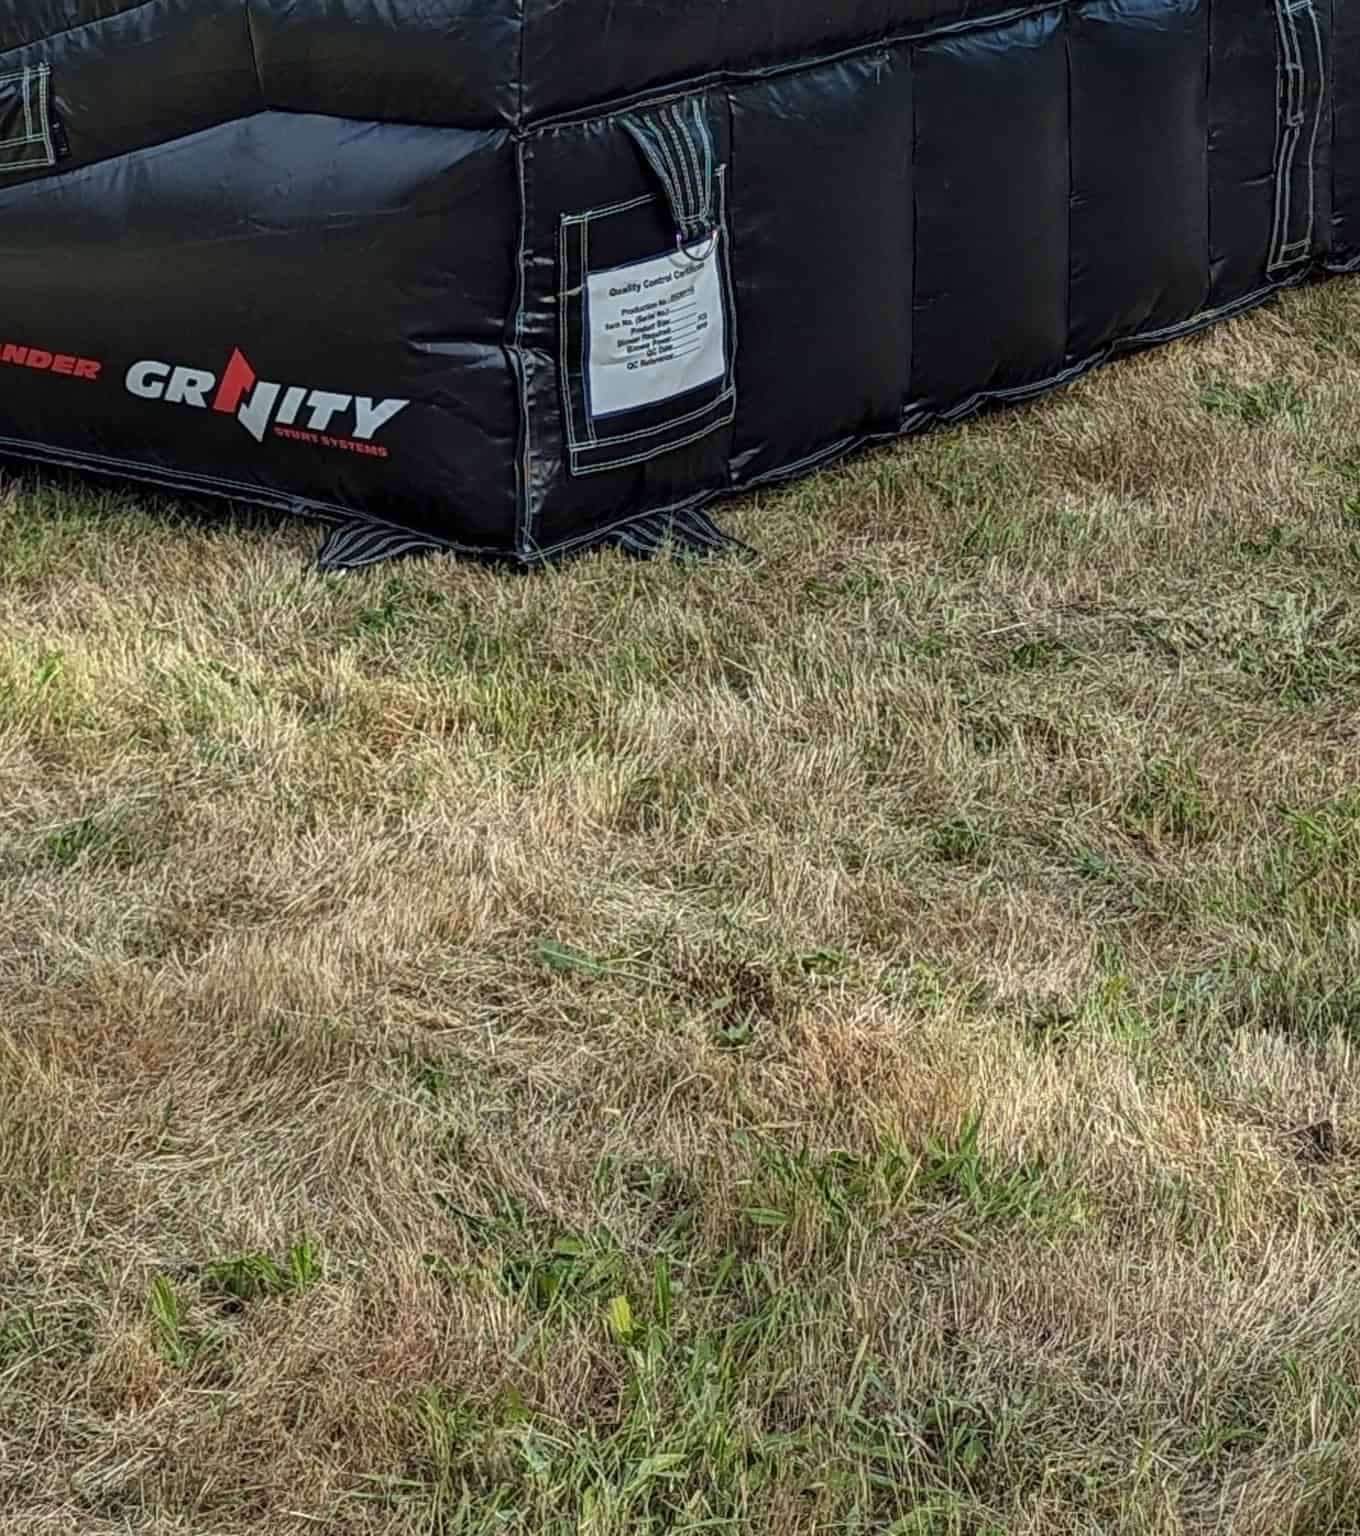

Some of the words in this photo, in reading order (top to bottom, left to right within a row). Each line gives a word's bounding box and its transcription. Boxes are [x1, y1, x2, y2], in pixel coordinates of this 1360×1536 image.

[609, 283, 641, 297] Quality
[643, 273, 672, 289] Control
[125, 345, 411, 443] GRAVITY
[320, 435, 390, 459] SYSTEMS
